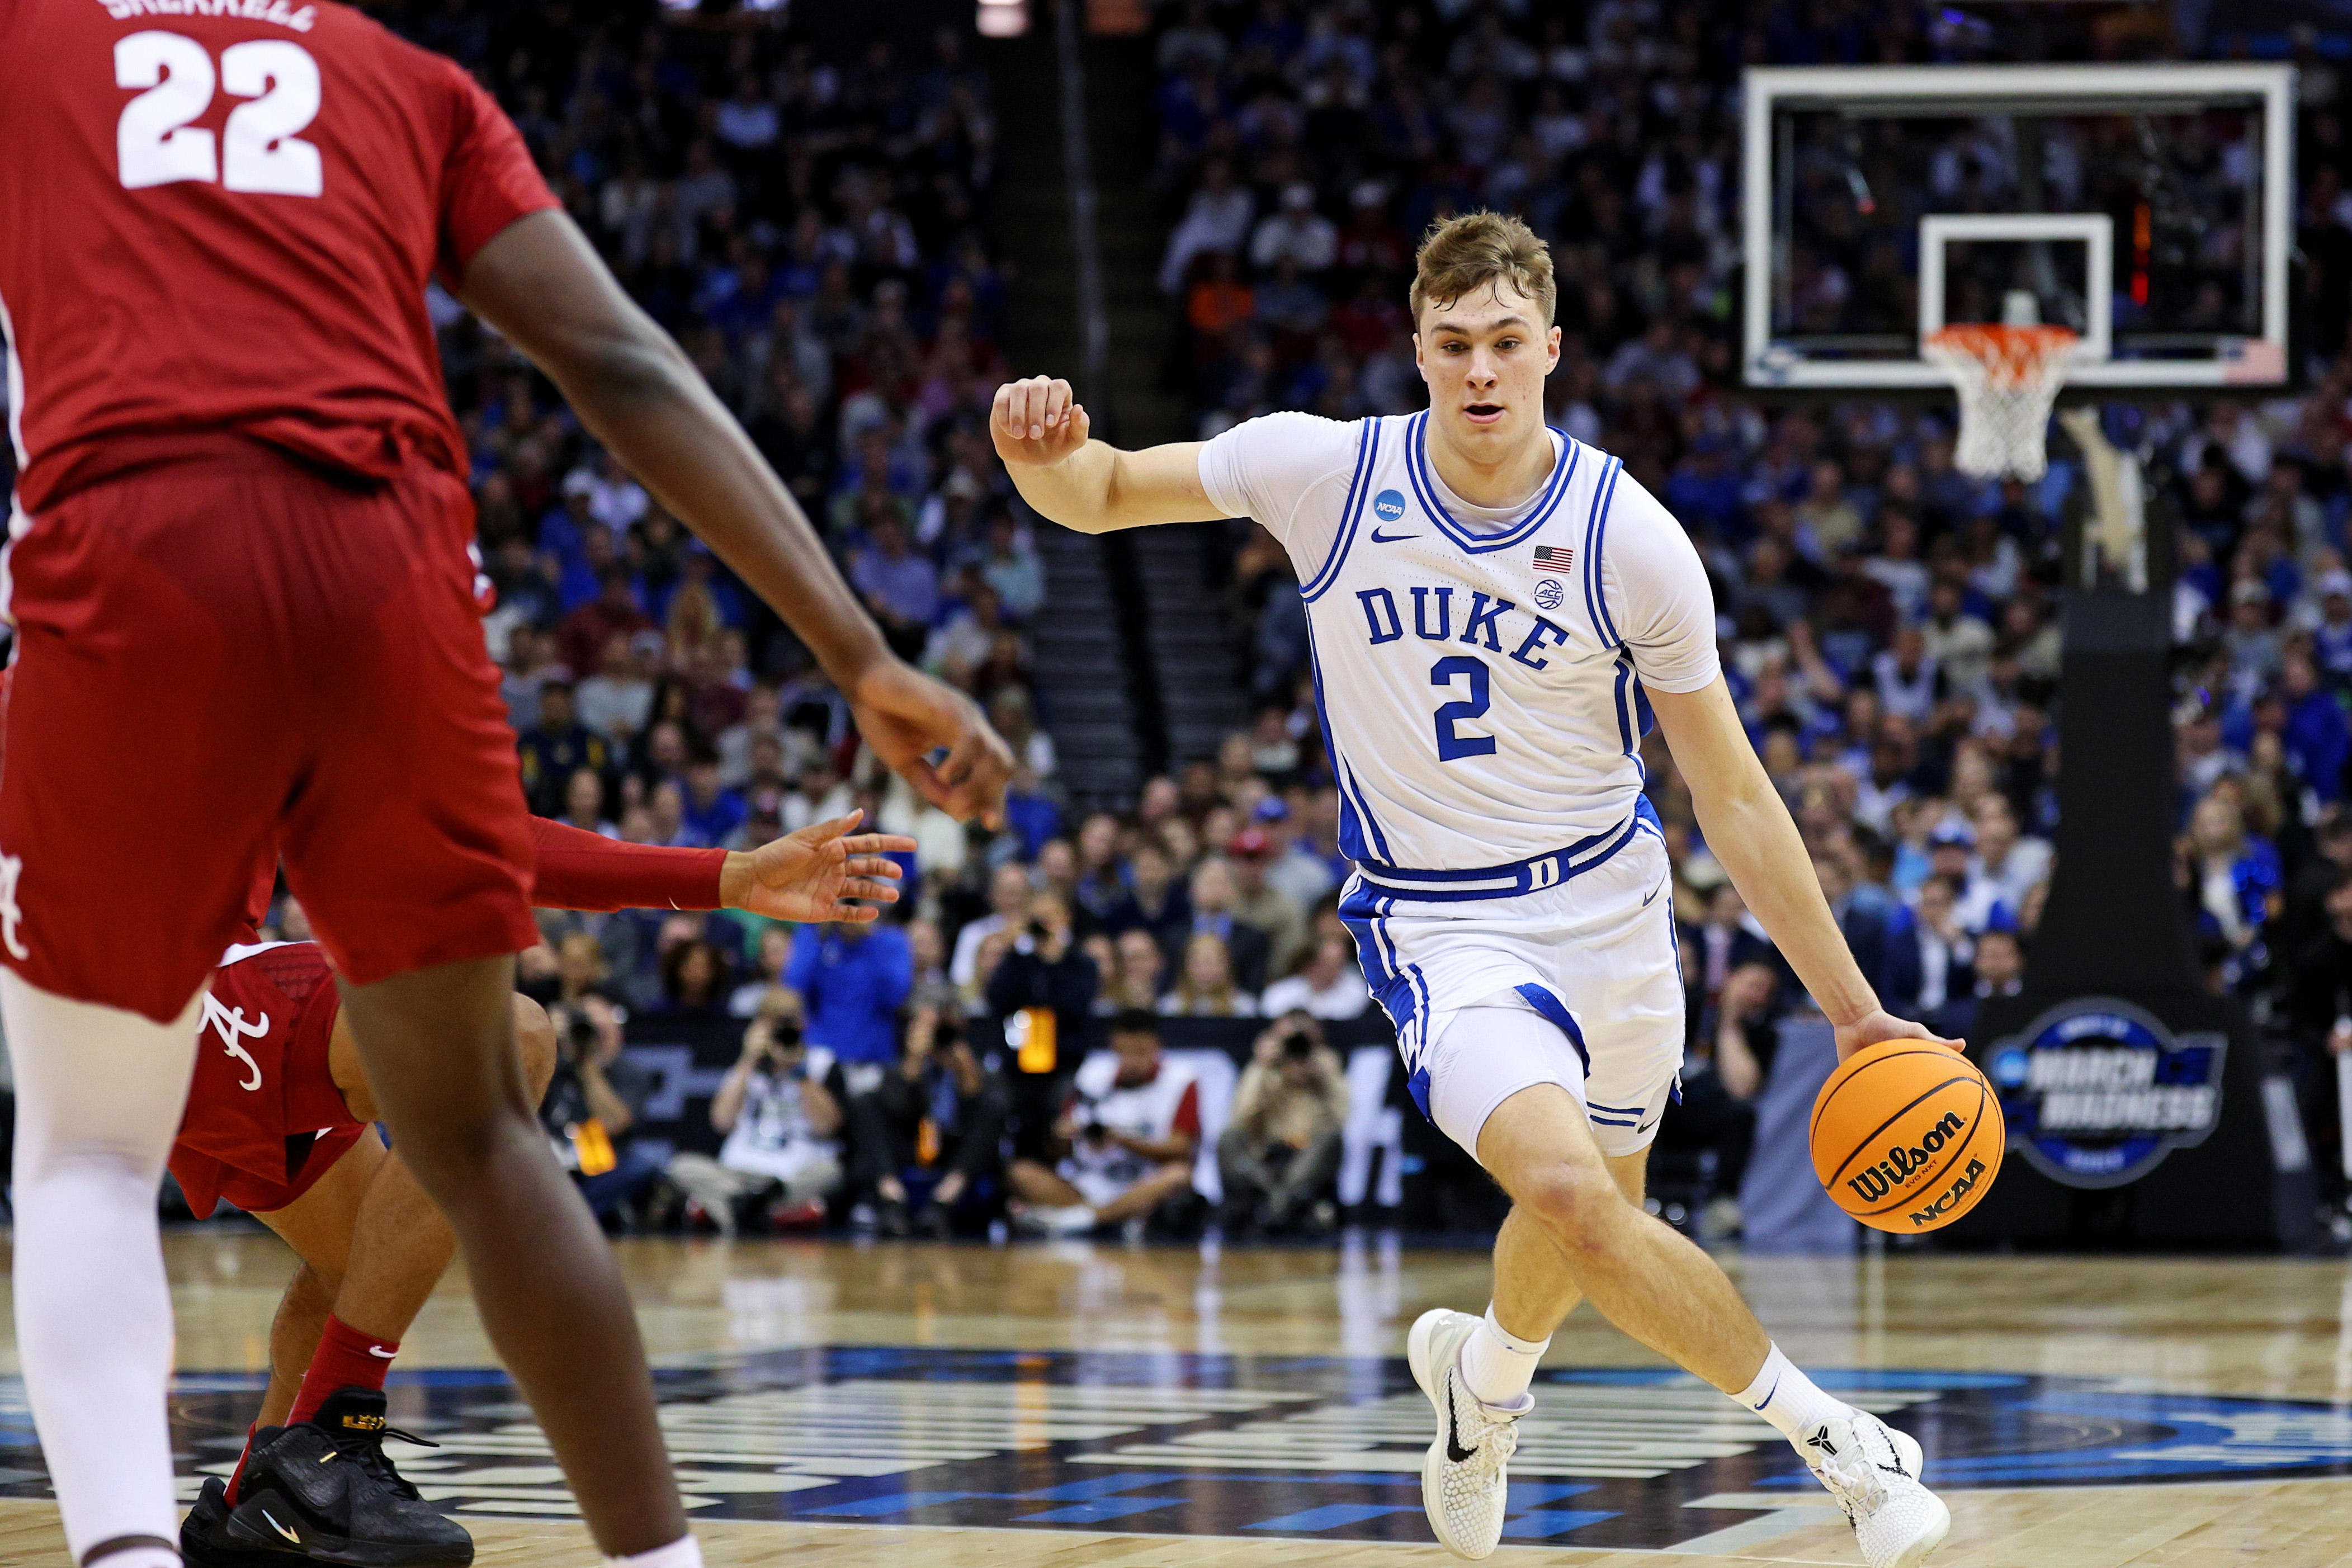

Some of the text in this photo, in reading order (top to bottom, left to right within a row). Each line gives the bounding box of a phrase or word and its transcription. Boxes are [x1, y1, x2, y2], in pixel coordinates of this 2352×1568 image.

[114, 30, 323, 197] 22
[1377, 502, 1402, 515] NCAA
[1538, 589, 1563, 598] ACC
[1356, 587, 1569, 670] DUKE
[1430, 656, 1497, 762] 2
[1528, 857, 1560, 891] D
[1848, 1111, 1966, 1203] Wilson
[1905, 1159, 1937, 1188] EVO NXT
[1907, 1158, 1986, 1226] NCAA
